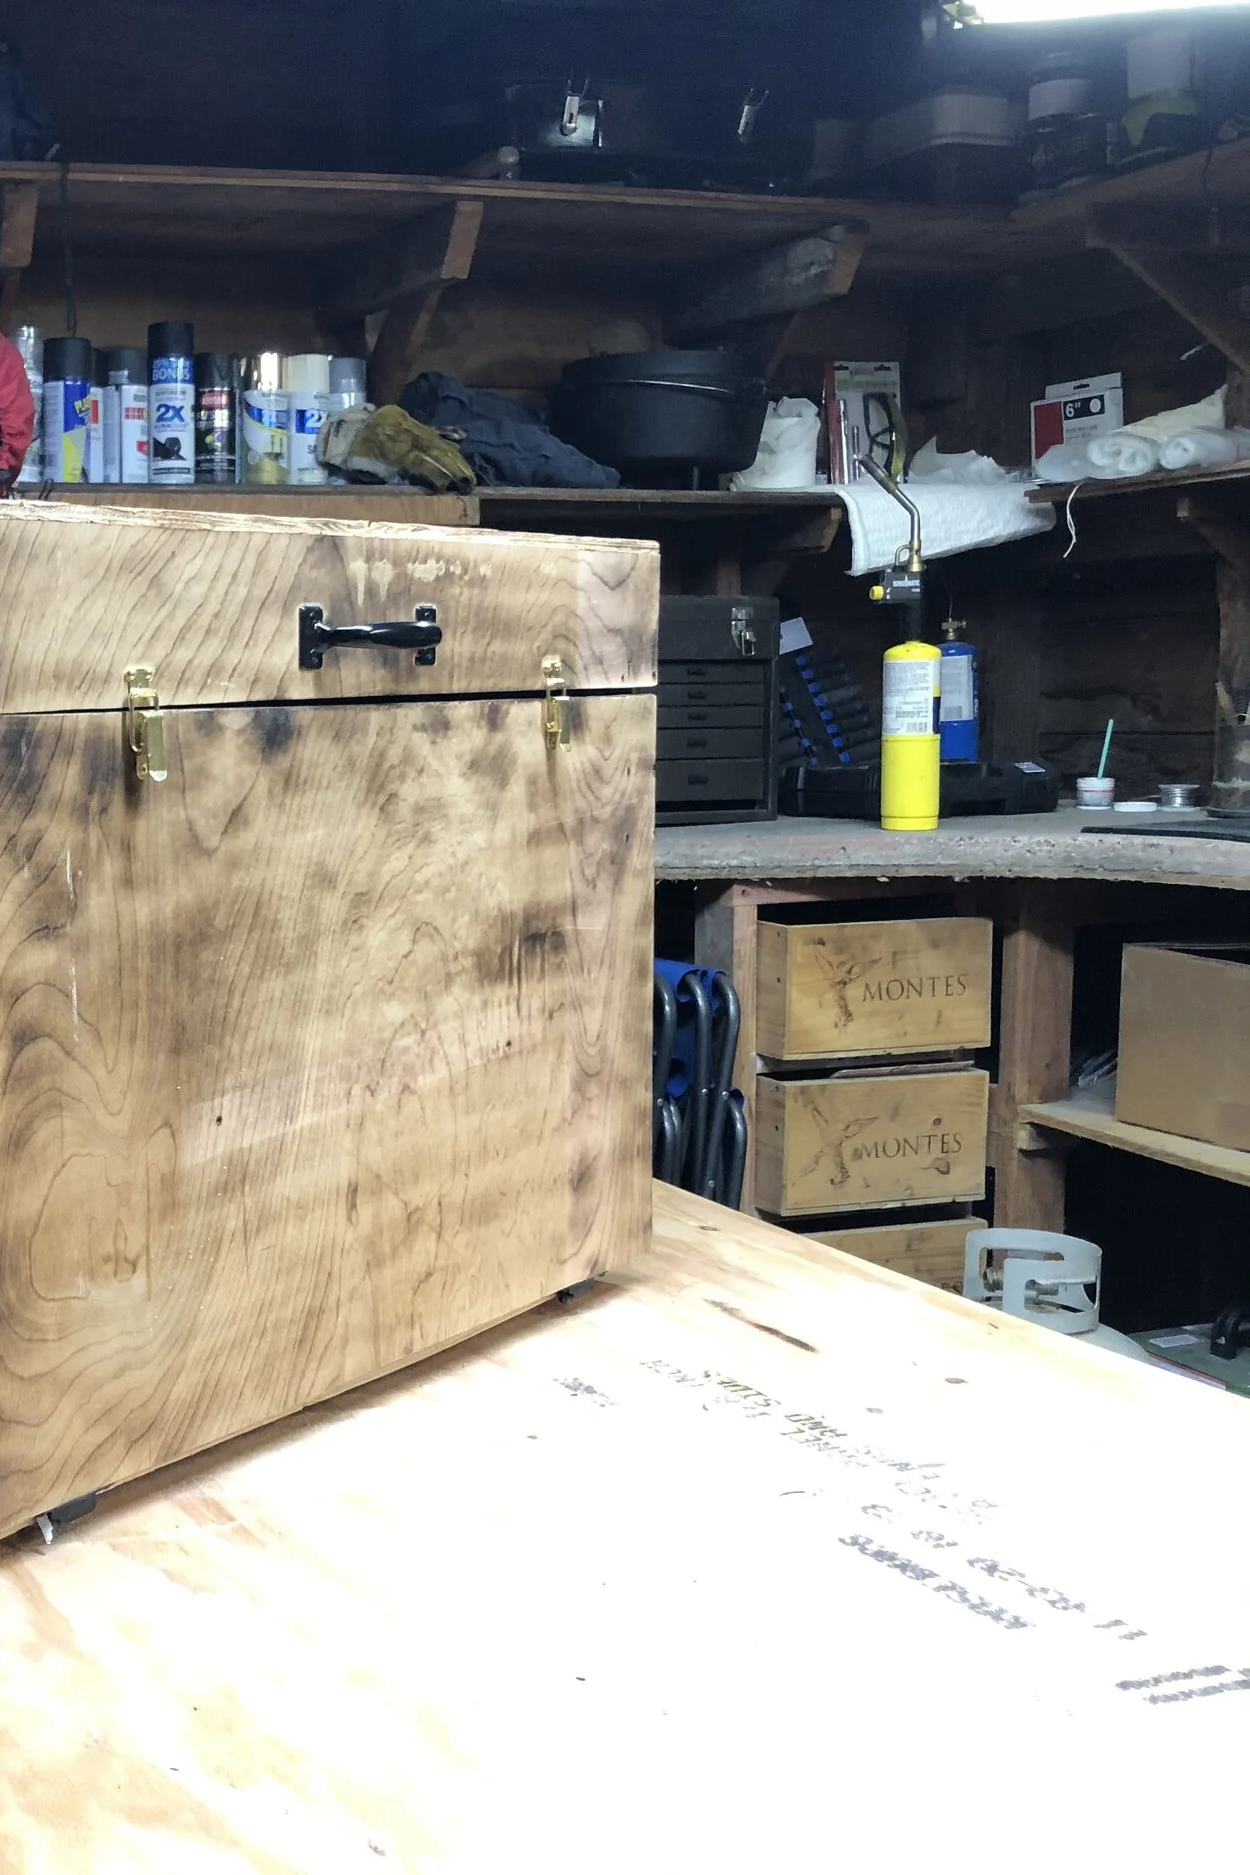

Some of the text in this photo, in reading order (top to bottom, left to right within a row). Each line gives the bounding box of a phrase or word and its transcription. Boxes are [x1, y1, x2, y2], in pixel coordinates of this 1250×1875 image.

[155, 403, 185, 423] 2X
[862, 973, 968, 1003] MONTES
[860, 1132, 963, 1159] MONTES
